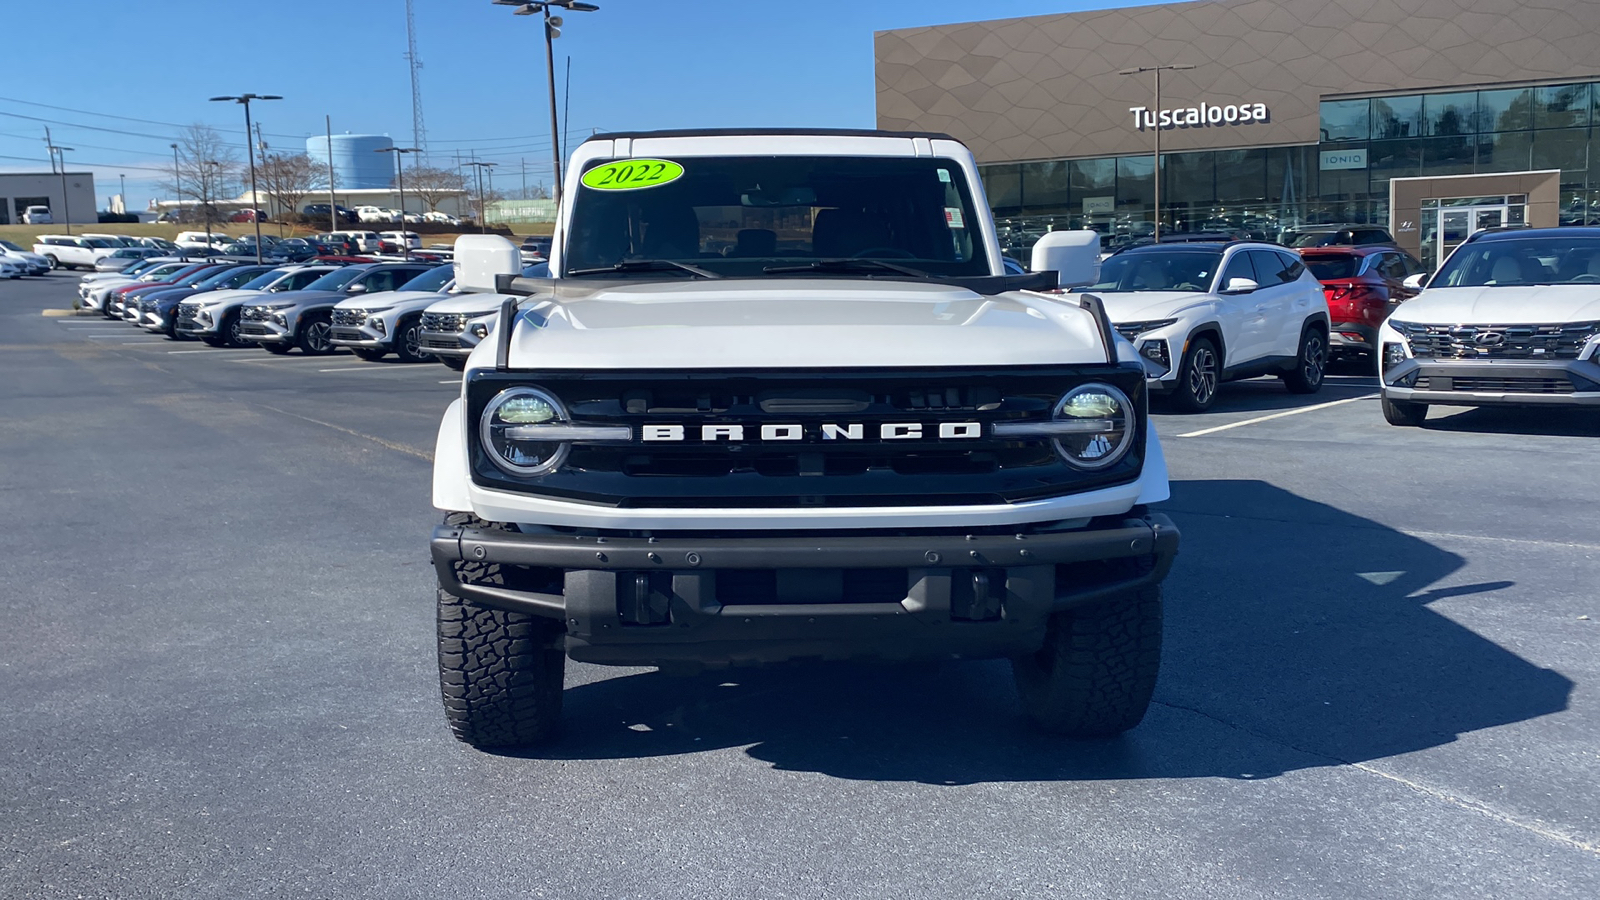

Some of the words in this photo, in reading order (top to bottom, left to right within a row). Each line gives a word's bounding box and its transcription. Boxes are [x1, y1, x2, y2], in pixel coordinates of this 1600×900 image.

[1129, 102, 1267, 128] Tuscaloosa
[597, 163, 666, 185] 2022
[642, 422, 981, 441] BRONCO
